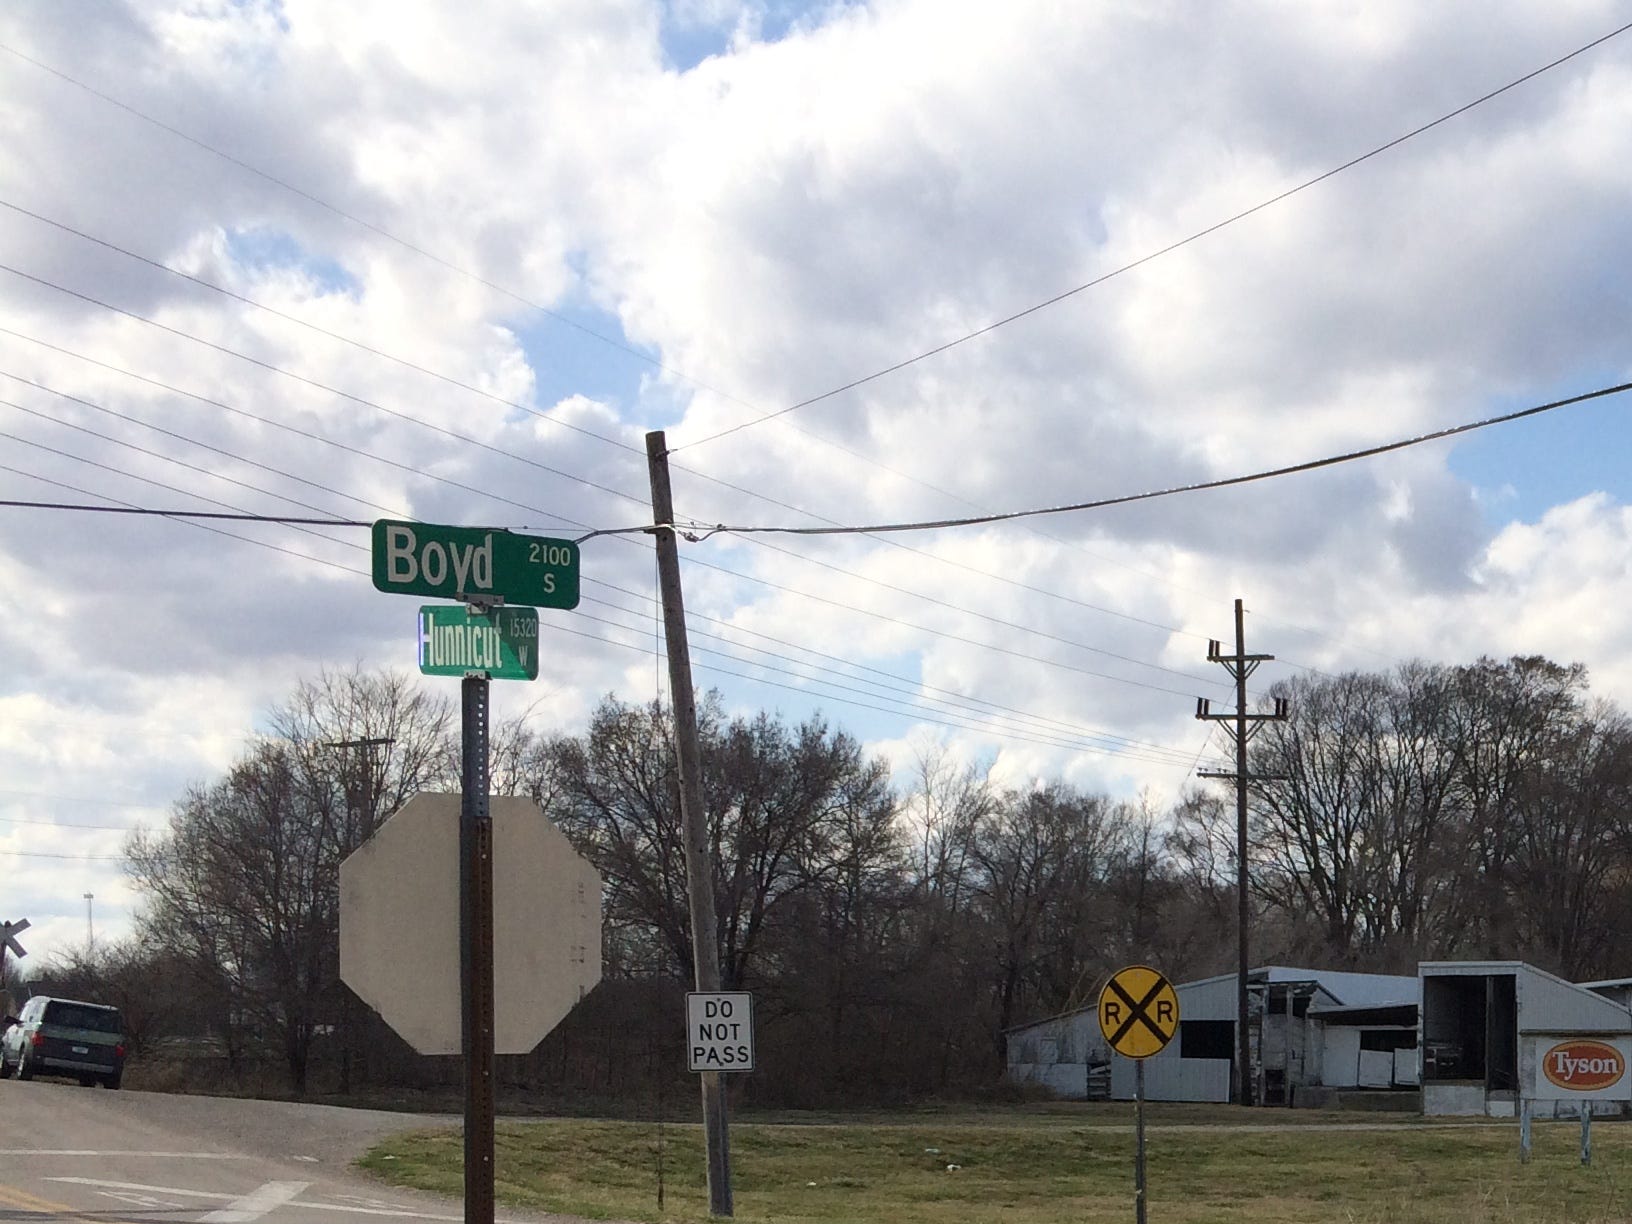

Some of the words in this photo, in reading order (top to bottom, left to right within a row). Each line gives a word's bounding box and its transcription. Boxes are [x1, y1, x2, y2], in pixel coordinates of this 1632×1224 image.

[386, 525, 493, 593] Boyd
[529, 543, 571, 566] 2100
[543, 573, 555, 593] S
[418, 611, 502, 668] Hunnicut
[518, 645, 529, 666] W
[705, 1000, 733, 1018] DO
[699, 1023, 741, 1041] NOT
[693, 1045, 749, 1064] PASS
[1552, 1051, 1619, 1081] Tyson
